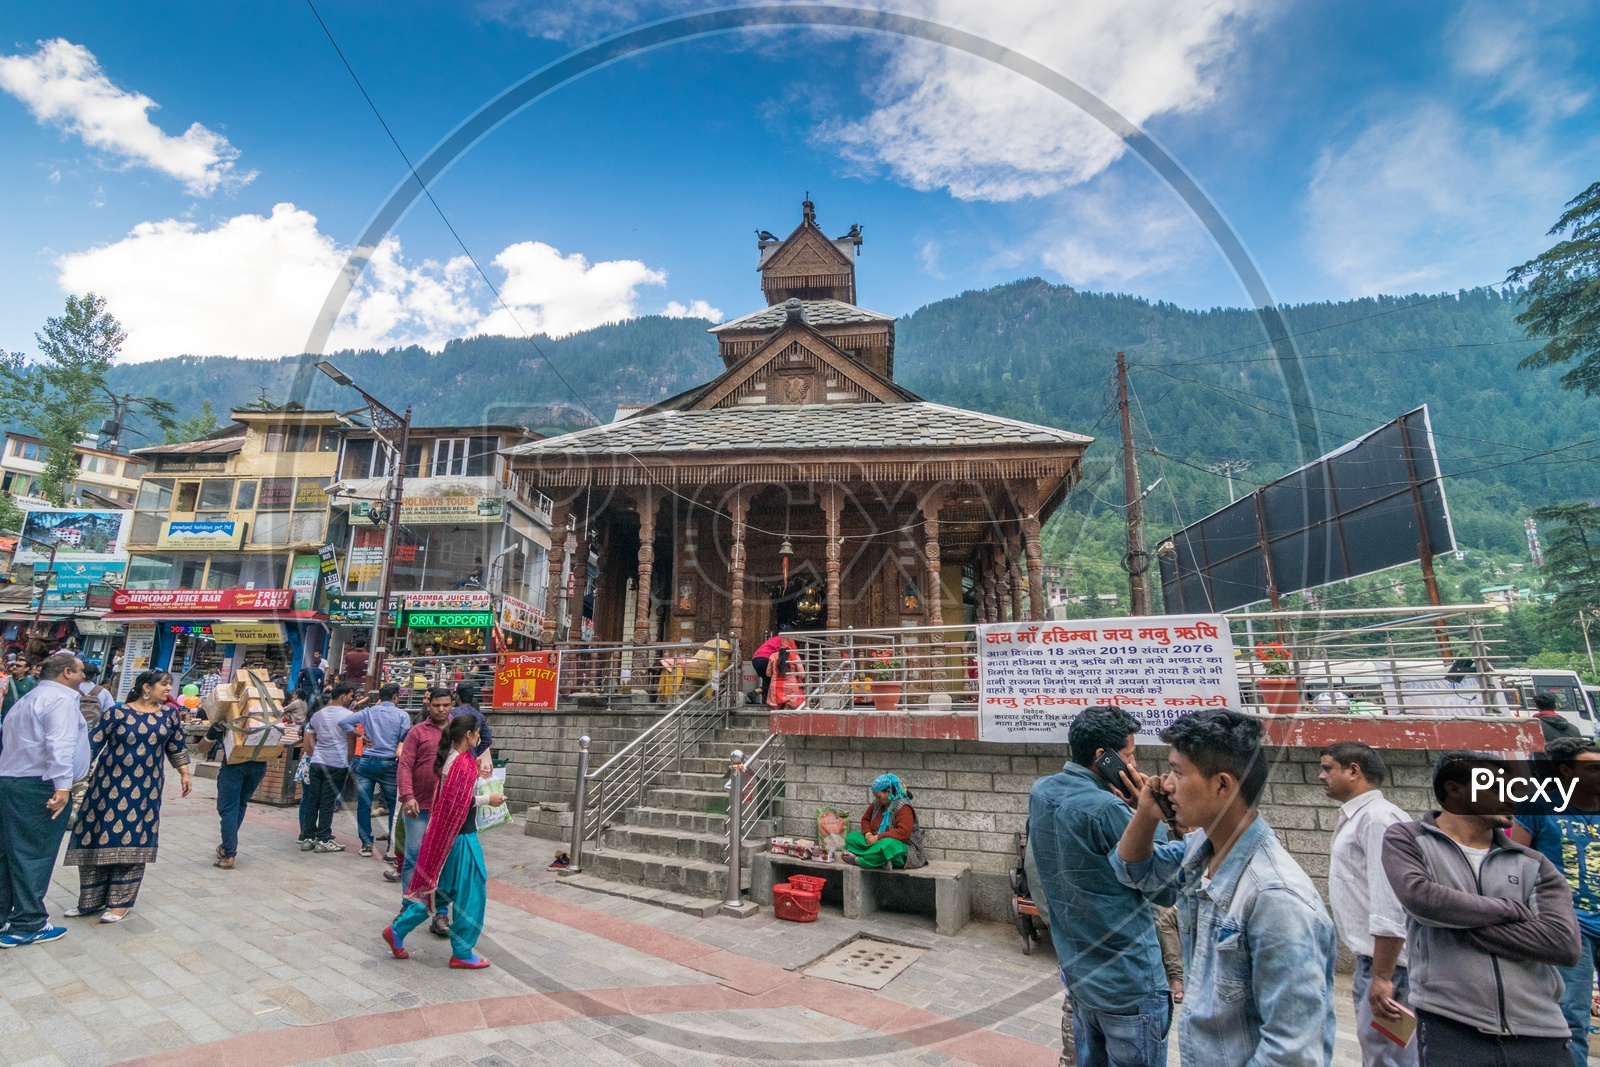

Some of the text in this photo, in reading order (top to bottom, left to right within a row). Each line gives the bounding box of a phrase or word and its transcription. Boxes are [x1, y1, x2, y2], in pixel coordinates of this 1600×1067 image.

[18, 498, 50, 508] RESTAURANT
[402, 496, 474, 506] HOLIDAYS TOURS
[324, 574, 340, 586] LEH
[130, 594, 174, 602] HIMCOOP
[175, 594, 200, 602] JUICE
[201, 594, 222, 602] BAR
[258, 591, 289, 600] FRUIT
[254, 600, 288, 608] BARFI
[341, 602, 397, 610] R.K. HOLIYS
[504, 596, 540, 616] HADIMBA JUICE
[986, 622, 1218, 645] जय माँ हडिम्बा जय मनु ऋषि
[1011, 648, 1044, 656] दिनांक
[1048, 648, 1064, 656] 18
[1100, 646, 1138, 655] 2019
[1172, 644, 1213, 654] 2076
[510, 654, 544, 664] मन्दिर
[1012, 658, 1046, 666] हडिम्बा
[1060, 660, 1079, 668] मनु
[1081, 656, 1106, 666] ऋषि
[1110, 657, 1124, 665] जी
[1146, 656, 1164, 664] नये
[498, 664, 556, 686] दुर्गा माता
[1032, 668, 1052, 676] विधि
[1055, 668, 1064, 676] के
[1068, 669, 1102, 678] अनुसार
[1144, 667, 1155, 676] हो
[1181, 666, 1190, 676] है
[1210, 666, 1223, 674] भी
[1043, 677, 1076, 686] निर्माण
[1079, 676, 1102, 686] कार्य
[1105, 677, 1114, 686] में
[1152, 676, 1196, 685] योगदान
[1199, 676, 1220, 684] देना
[1059, 686, 1068, 694] के
[1070, 687, 1084, 695] इस
[1086, 686, 1098, 694] पते
[1116, 686, 1145, 694] सम्पर्क
[1148, 686, 1162, 694] करें
[986, 694, 1228, 708] मनु हडिम्बा मन्दिर कमेटी
